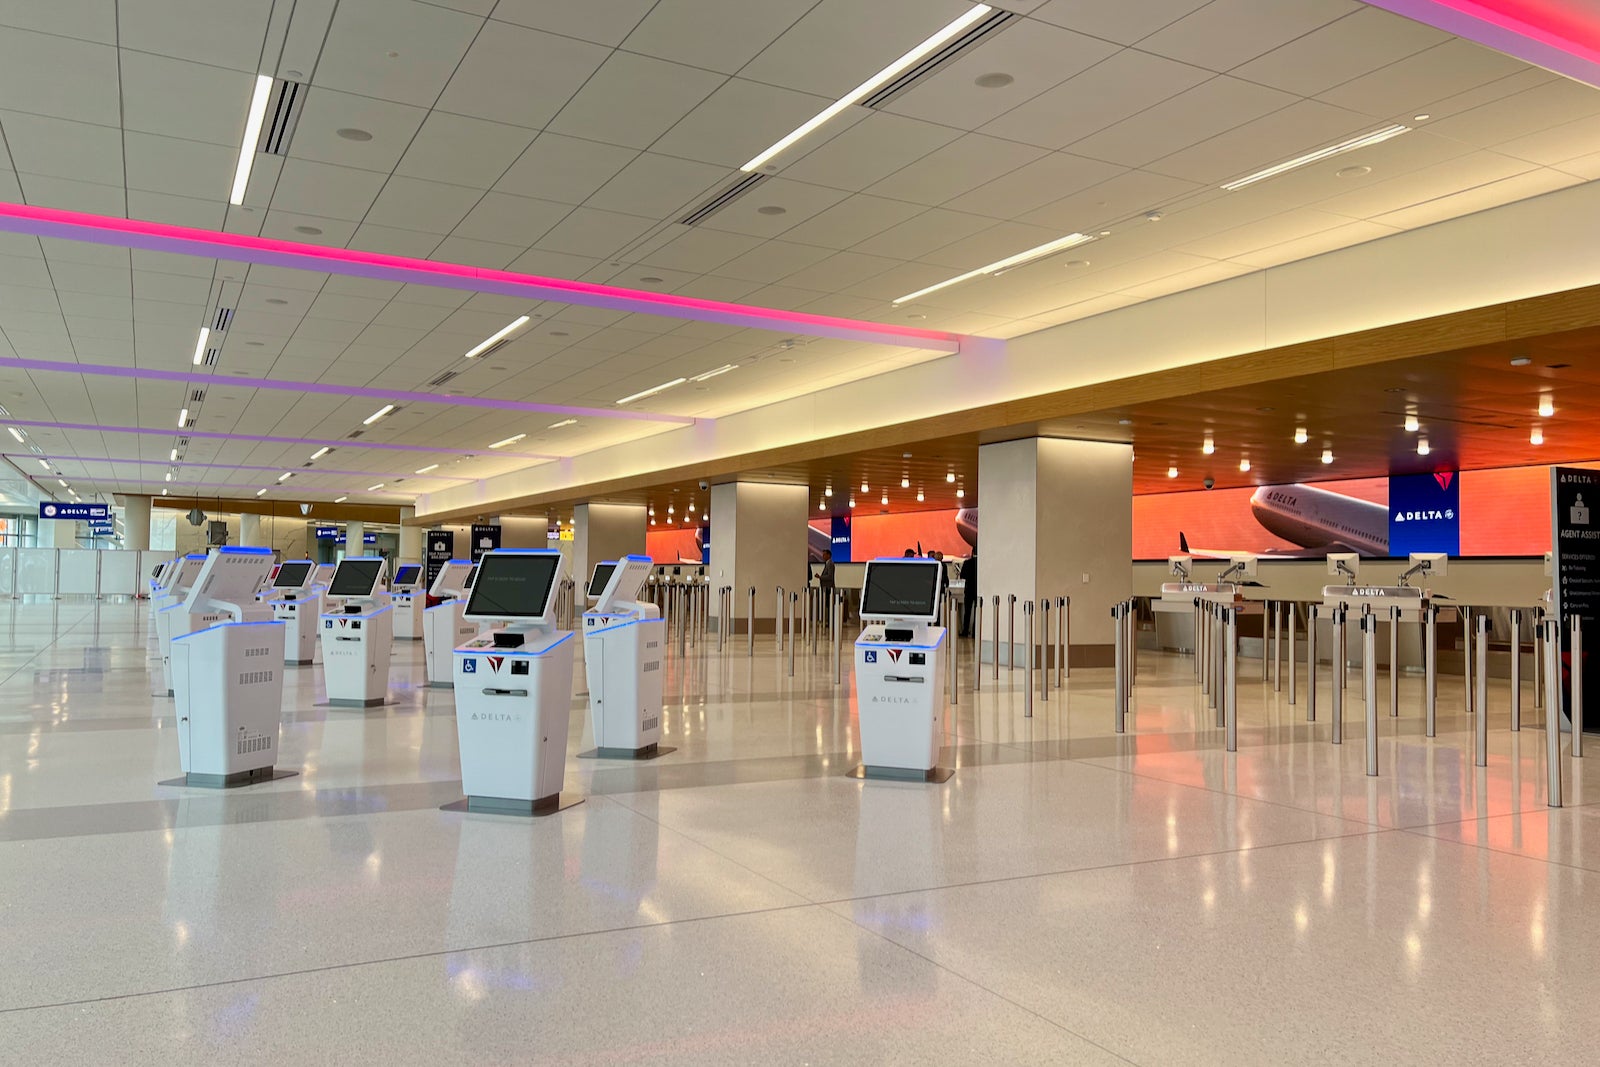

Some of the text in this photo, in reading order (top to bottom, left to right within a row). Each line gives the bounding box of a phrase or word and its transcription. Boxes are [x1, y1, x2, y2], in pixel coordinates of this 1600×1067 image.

[1567, 474, 1591, 484] DELTA
[1272, 492, 1297, 507] DELTA
[1406, 510, 1442, 520] DELTA
[1561, 529, 1600, 540] AGENT ASSIST
[1359, 588, 1385, 596] DELTA
[880, 696, 909, 704] DELTA
[481, 712, 511, 721] DELTA
